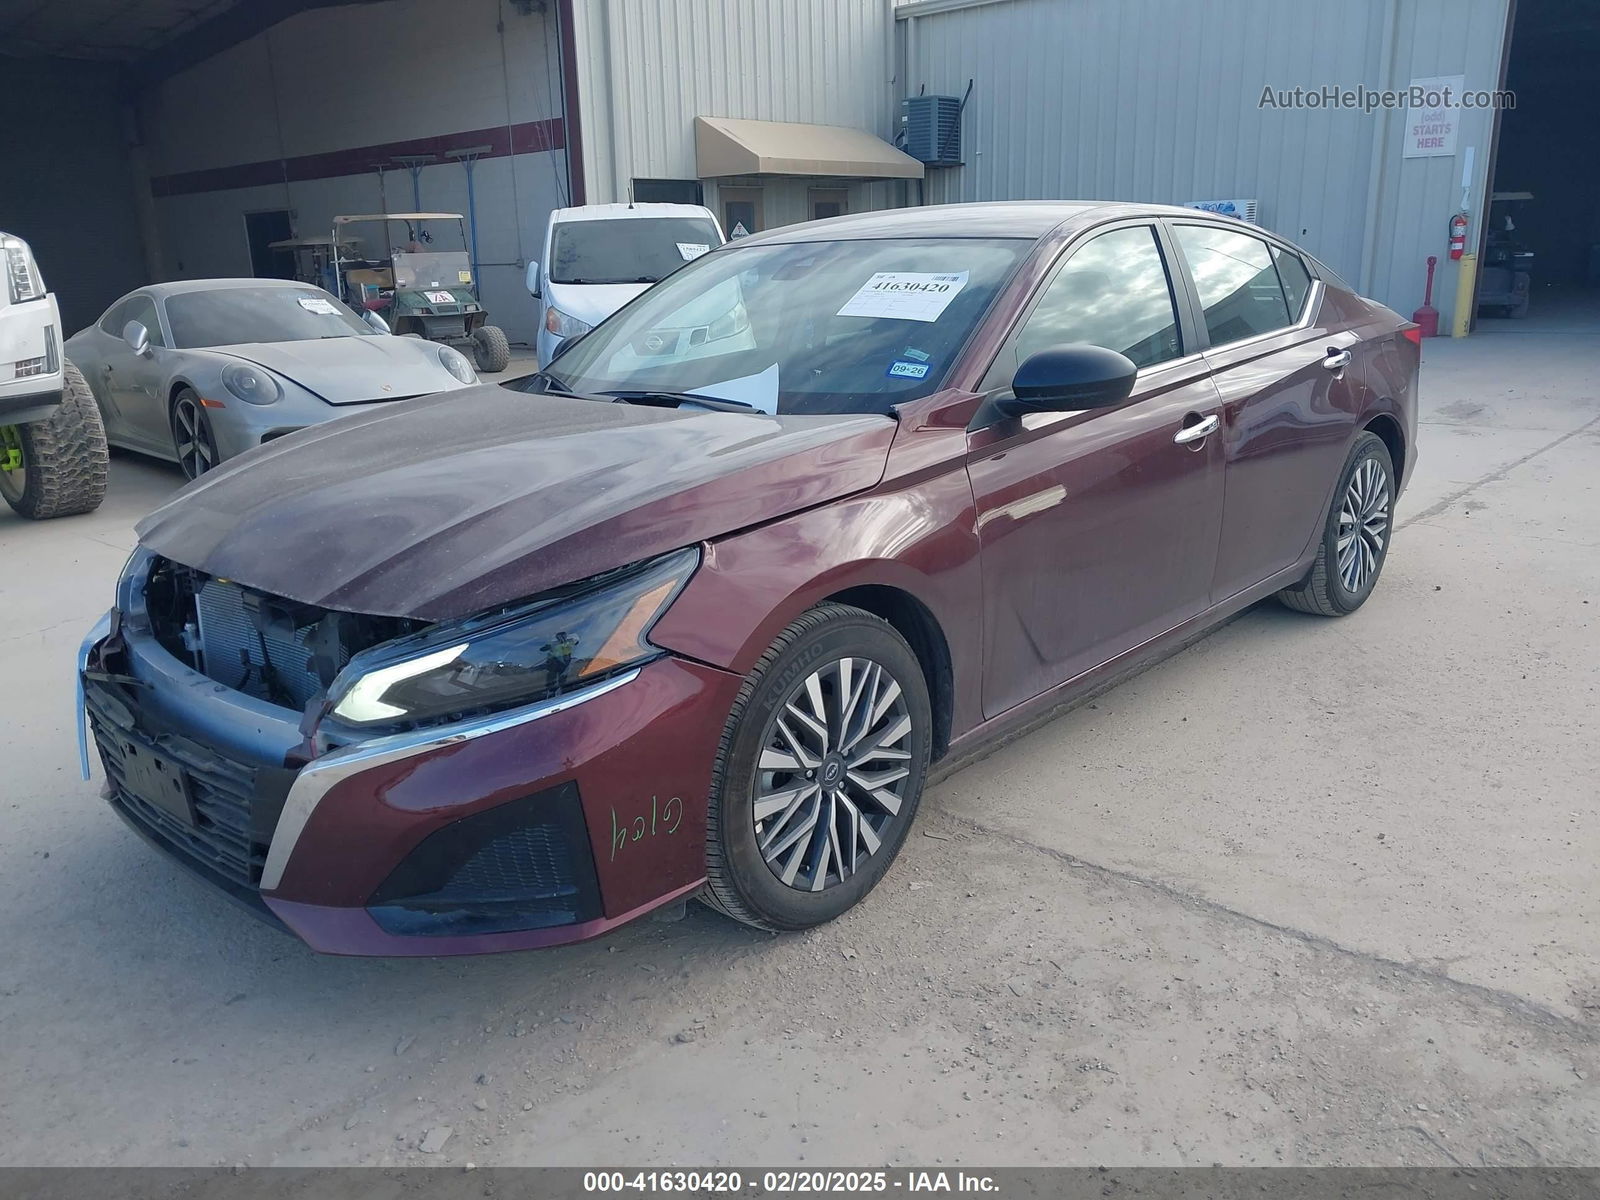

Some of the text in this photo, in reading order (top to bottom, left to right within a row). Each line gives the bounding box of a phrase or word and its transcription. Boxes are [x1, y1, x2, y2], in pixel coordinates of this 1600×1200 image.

[1413, 123, 1452, 136] STARTS
[1416, 137, 1444, 149] HERE
[872, 281, 950, 293] 41630420
[763, 643, 823, 709] KUMHO
